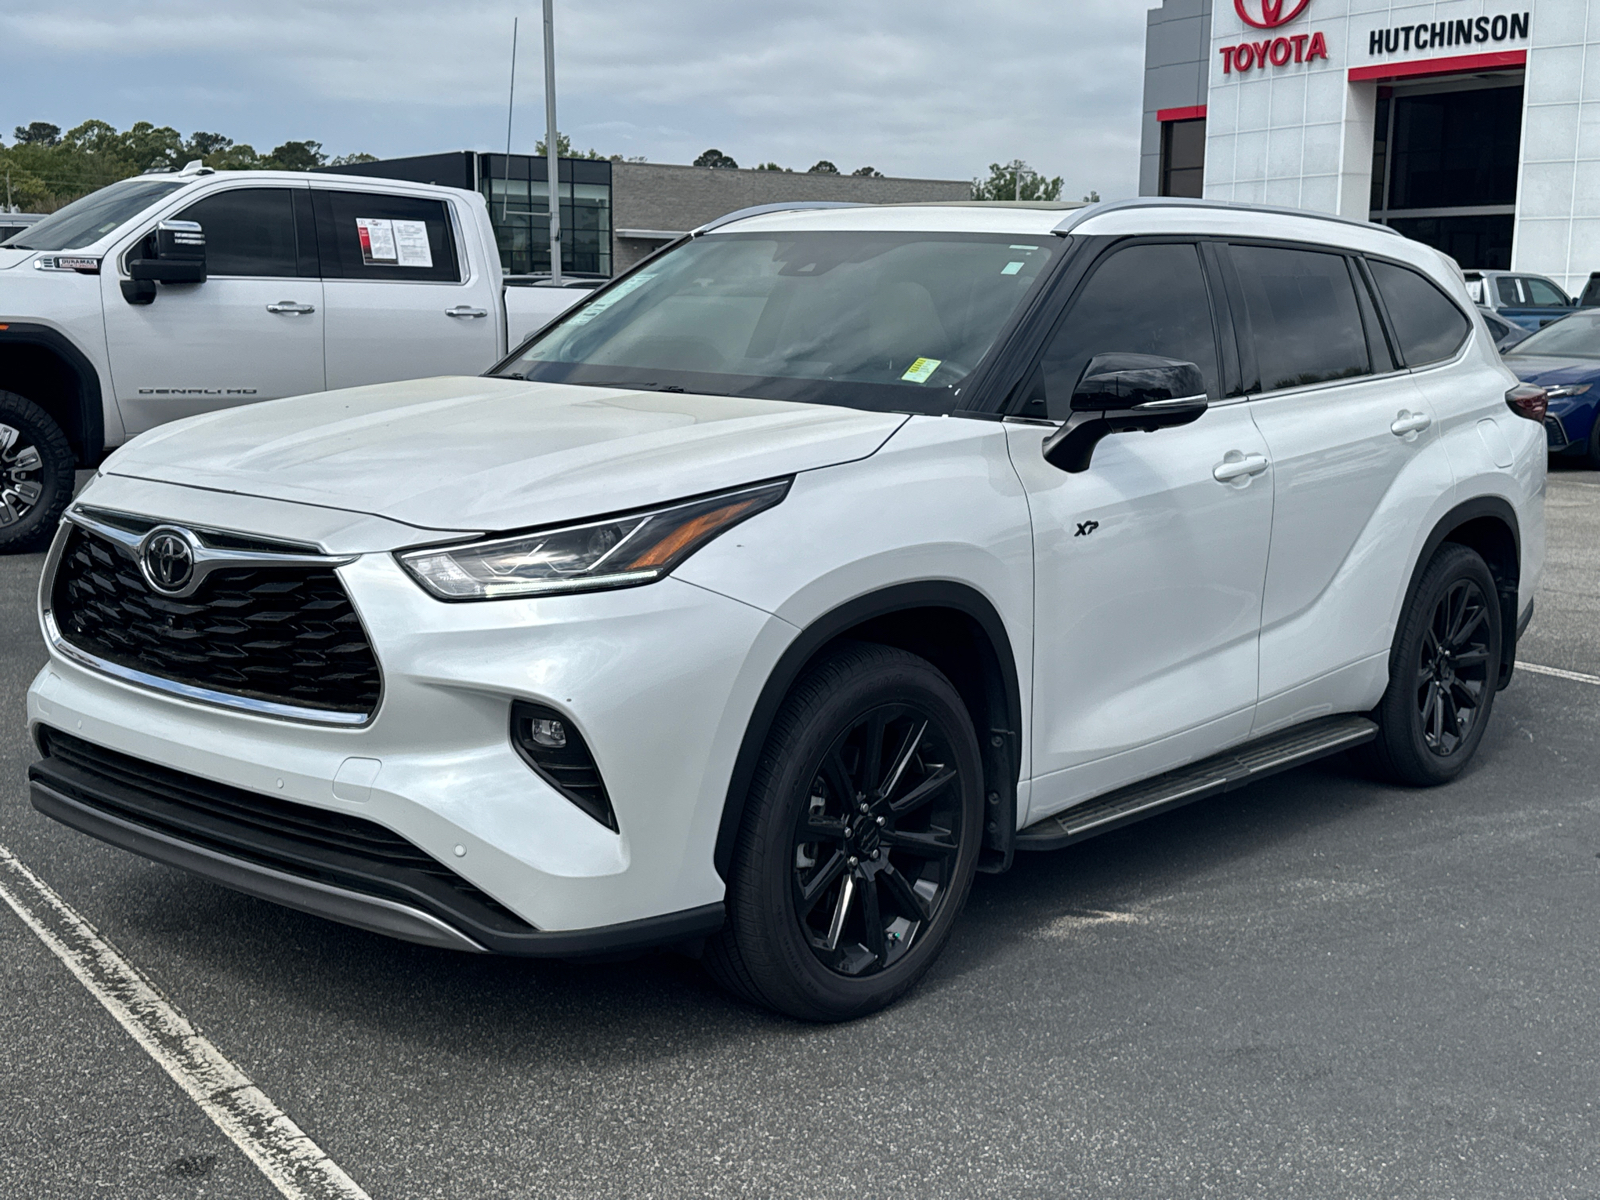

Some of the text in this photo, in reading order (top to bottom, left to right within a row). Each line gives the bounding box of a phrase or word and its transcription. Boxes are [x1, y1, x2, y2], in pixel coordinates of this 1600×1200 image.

[1219, 31, 1328, 74] TOYOTA
[1369, 12, 1529, 55] HUTCHINSON
[1074, 520, 1099, 537] XP
